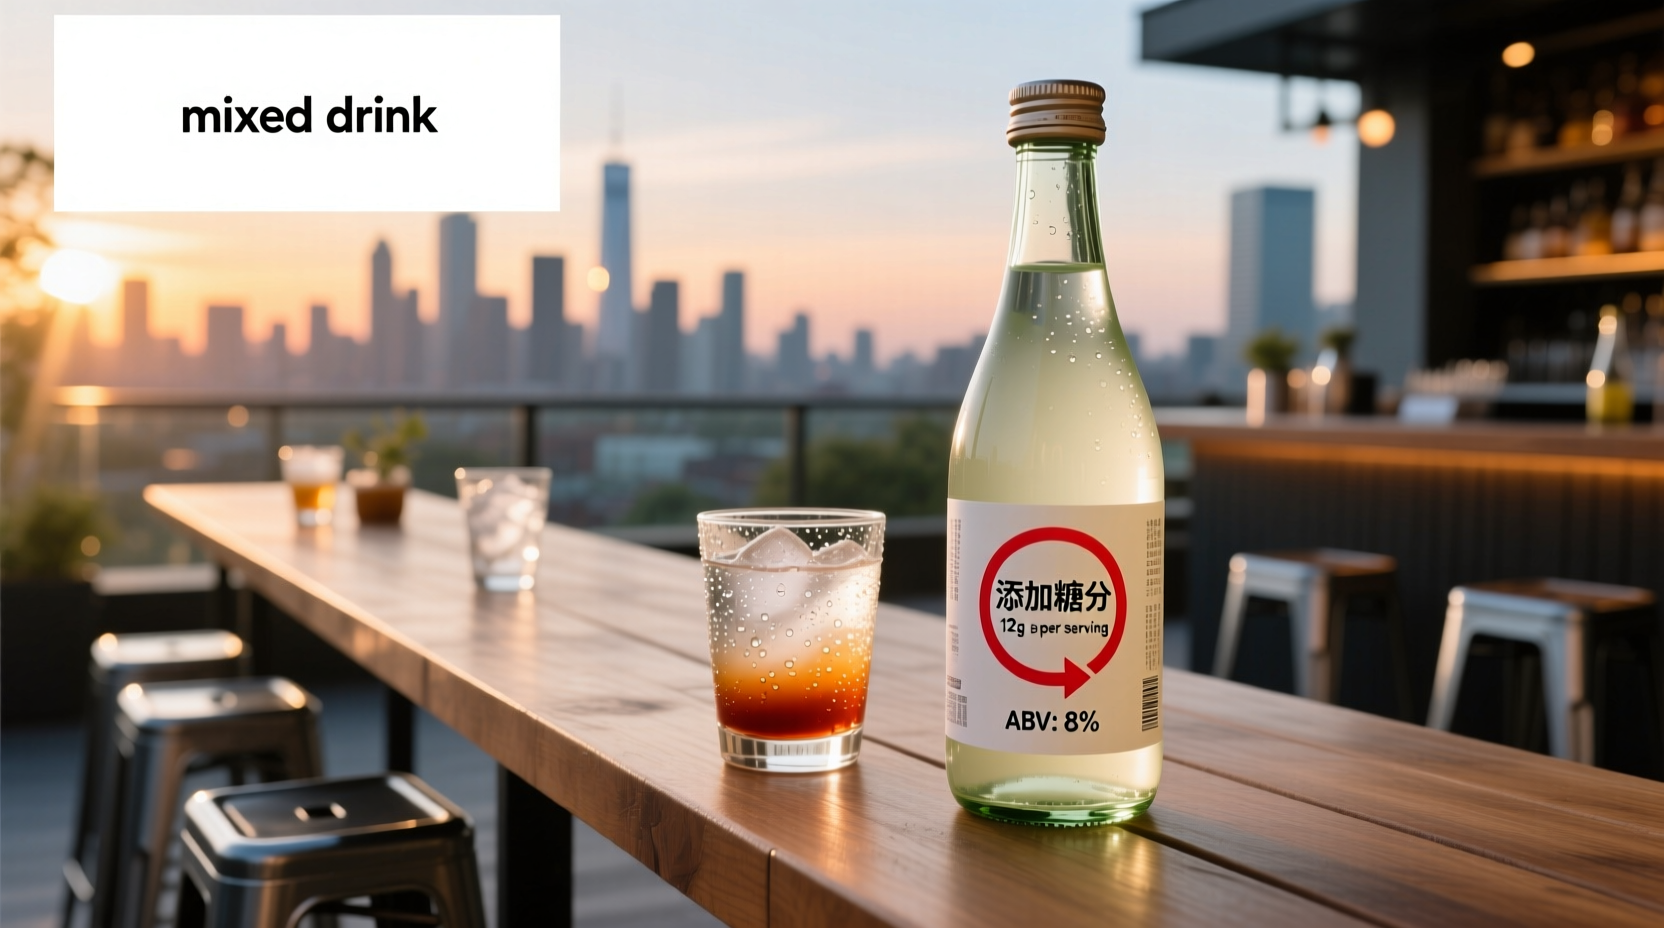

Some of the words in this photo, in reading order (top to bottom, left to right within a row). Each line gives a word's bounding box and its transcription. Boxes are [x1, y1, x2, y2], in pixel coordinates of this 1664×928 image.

[996, 579, 1112, 613] 添加糖分
[1000, 617, 1025, 638] 12g
[1064, 620, 1109, 638] serving
[1005, 709, 1058, 732] ABV:
[1064, 709, 1100, 733] 8%
